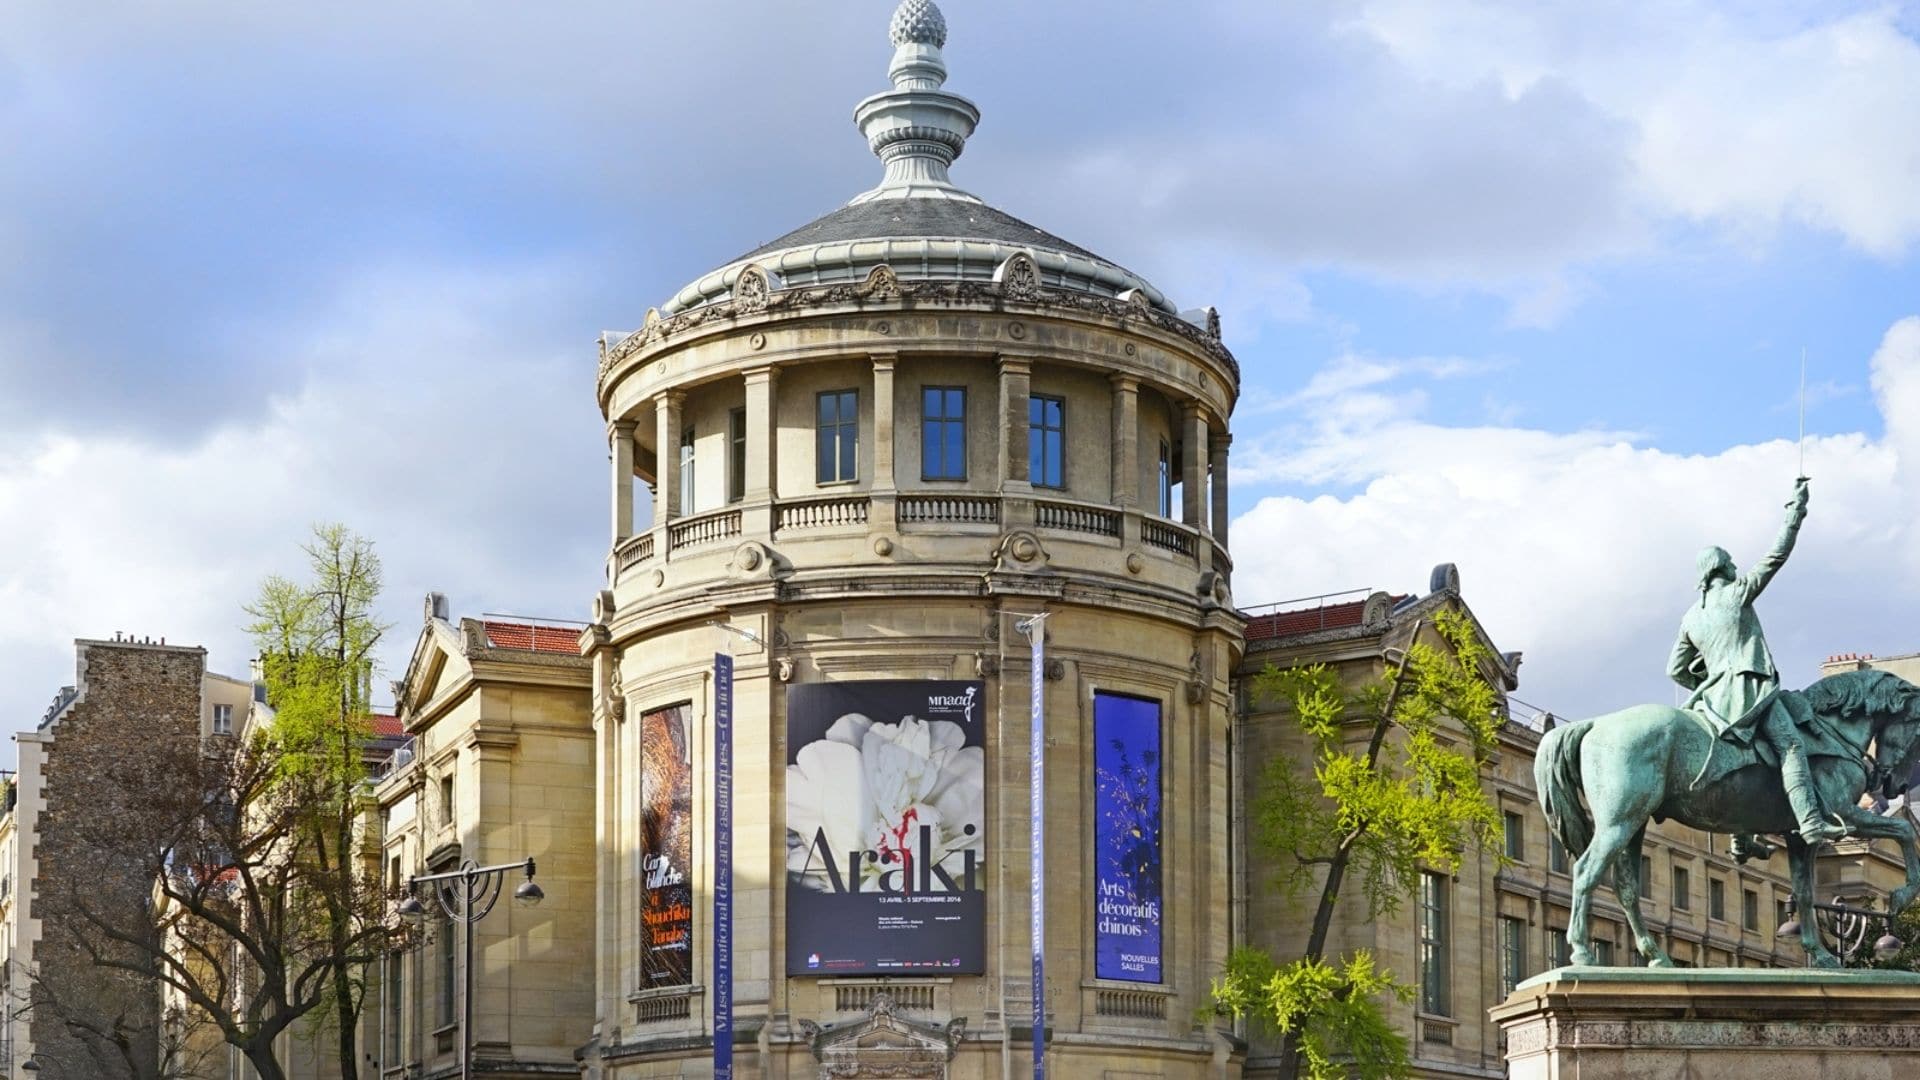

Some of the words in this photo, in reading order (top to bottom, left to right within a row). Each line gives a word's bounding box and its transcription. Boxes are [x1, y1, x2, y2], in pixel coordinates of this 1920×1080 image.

[717, 664, 729, 728] Guimet
[1032, 653, 1041, 718] Guimet
[717, 743, 732, 827] asiatiques
[717, 832, 729, 863] arts
[798, 824, 977, 894] Araki
[715, 868, 728, 898] des
[1098, 878, 1125, 897] Arts
[1099, 898, 1159, 919] décoratifs
[715, 903, 728, 969] national
[1099, 917, 1142, 936] chinois
[1121, 954, 1159, 965] NOUVELLES
[1121, 962, 1145, 972] SALLES
